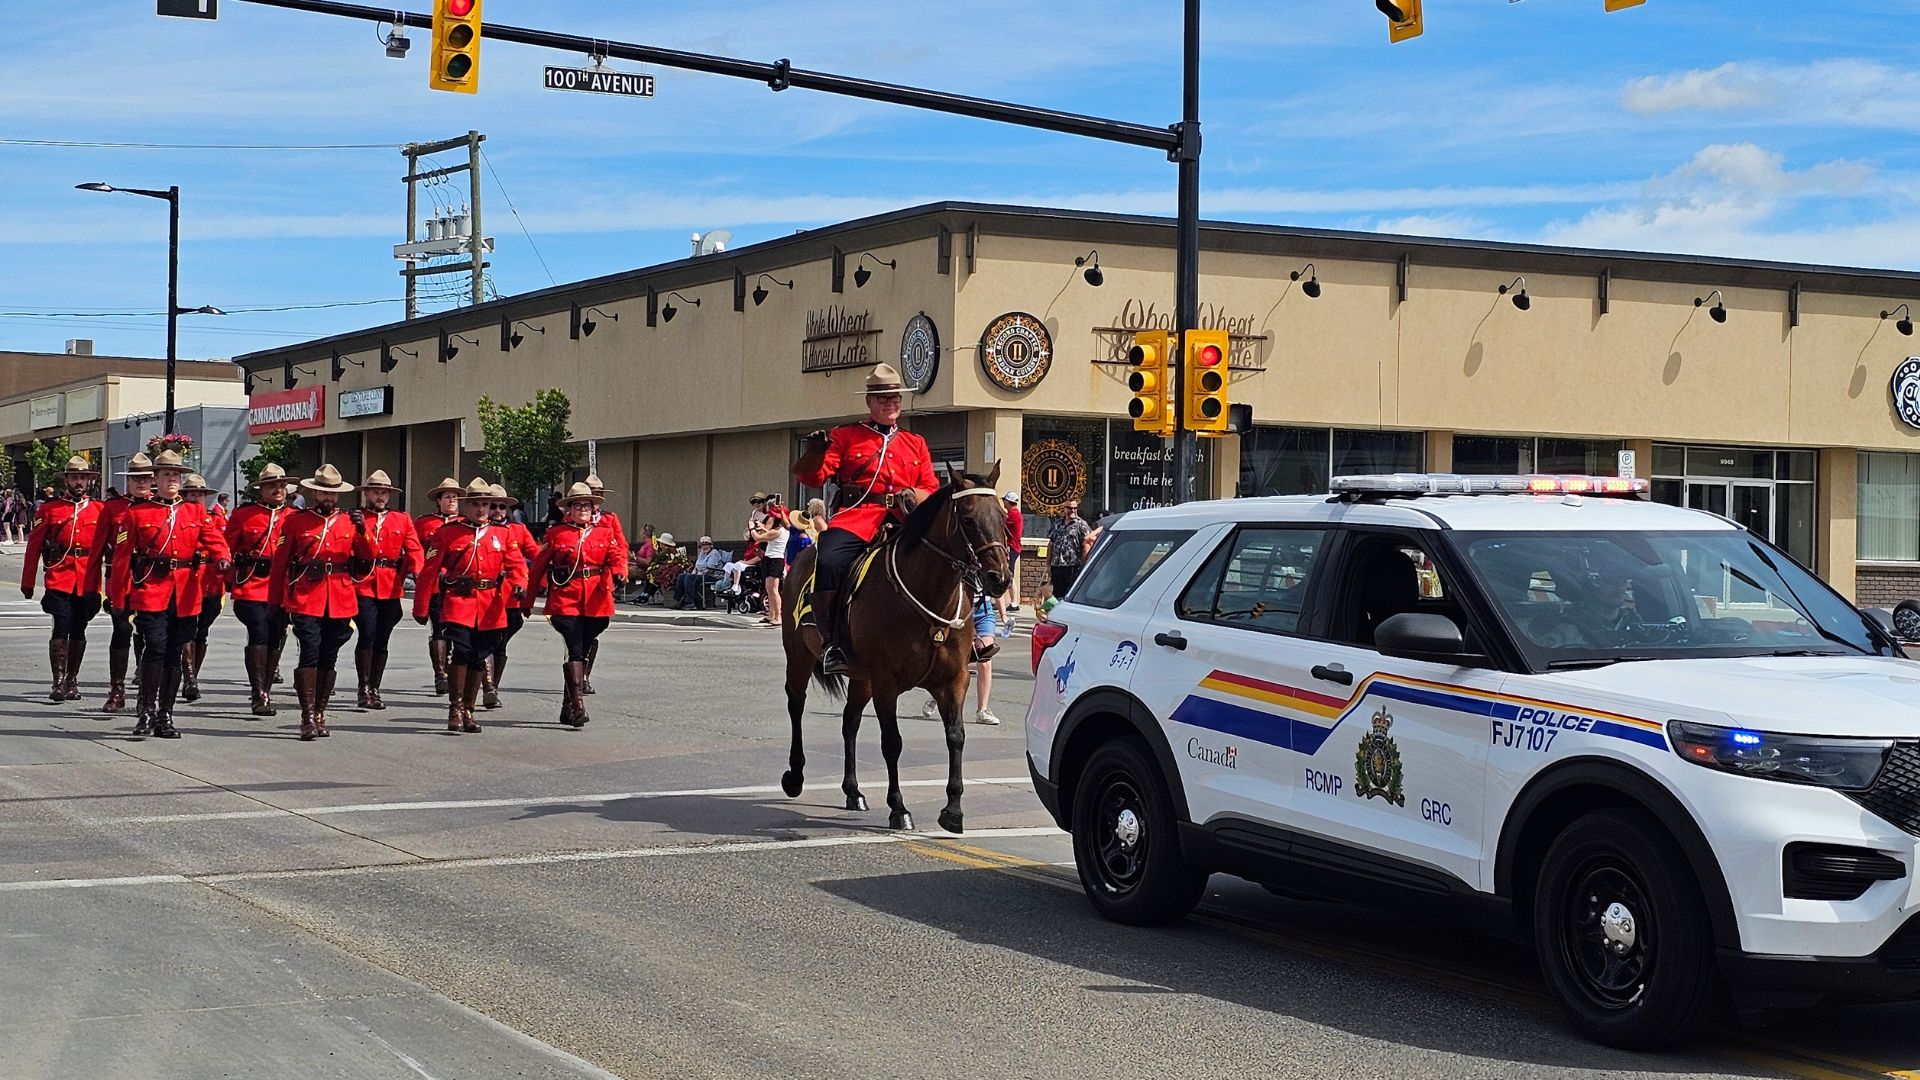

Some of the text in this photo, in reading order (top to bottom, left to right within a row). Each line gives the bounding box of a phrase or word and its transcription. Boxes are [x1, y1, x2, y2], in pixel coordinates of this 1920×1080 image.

[591, 74, 653, 94] AVENUE
[827, 304, 869, 334] Wheat
[1122, 299, 1177, 329] Whol
[996, 327, 1039, 352] SECOND CHAPTER
[808, 341, 835, 377] Honey
[996, 354, 1014, 375] INDIAN
[275, 401, 310, 422] CABANA
[1114, 445, 1174, 465] breakfast &
[1129, 472, 1140, 485] in
[1142, 472, 1158, 486] the
[1132, 496, 1146, 511] of
[1109, 654, 1135, 670] 9-1-1
[1518, 707, 1592, 732] POLICE
[1492, 720, 1559, 753] FJ7107
[1187, 737, 1237, 770] Canada
[1305, 768, 1343, 796] RCMP
[1421, 798, 1451, 825] GRC
